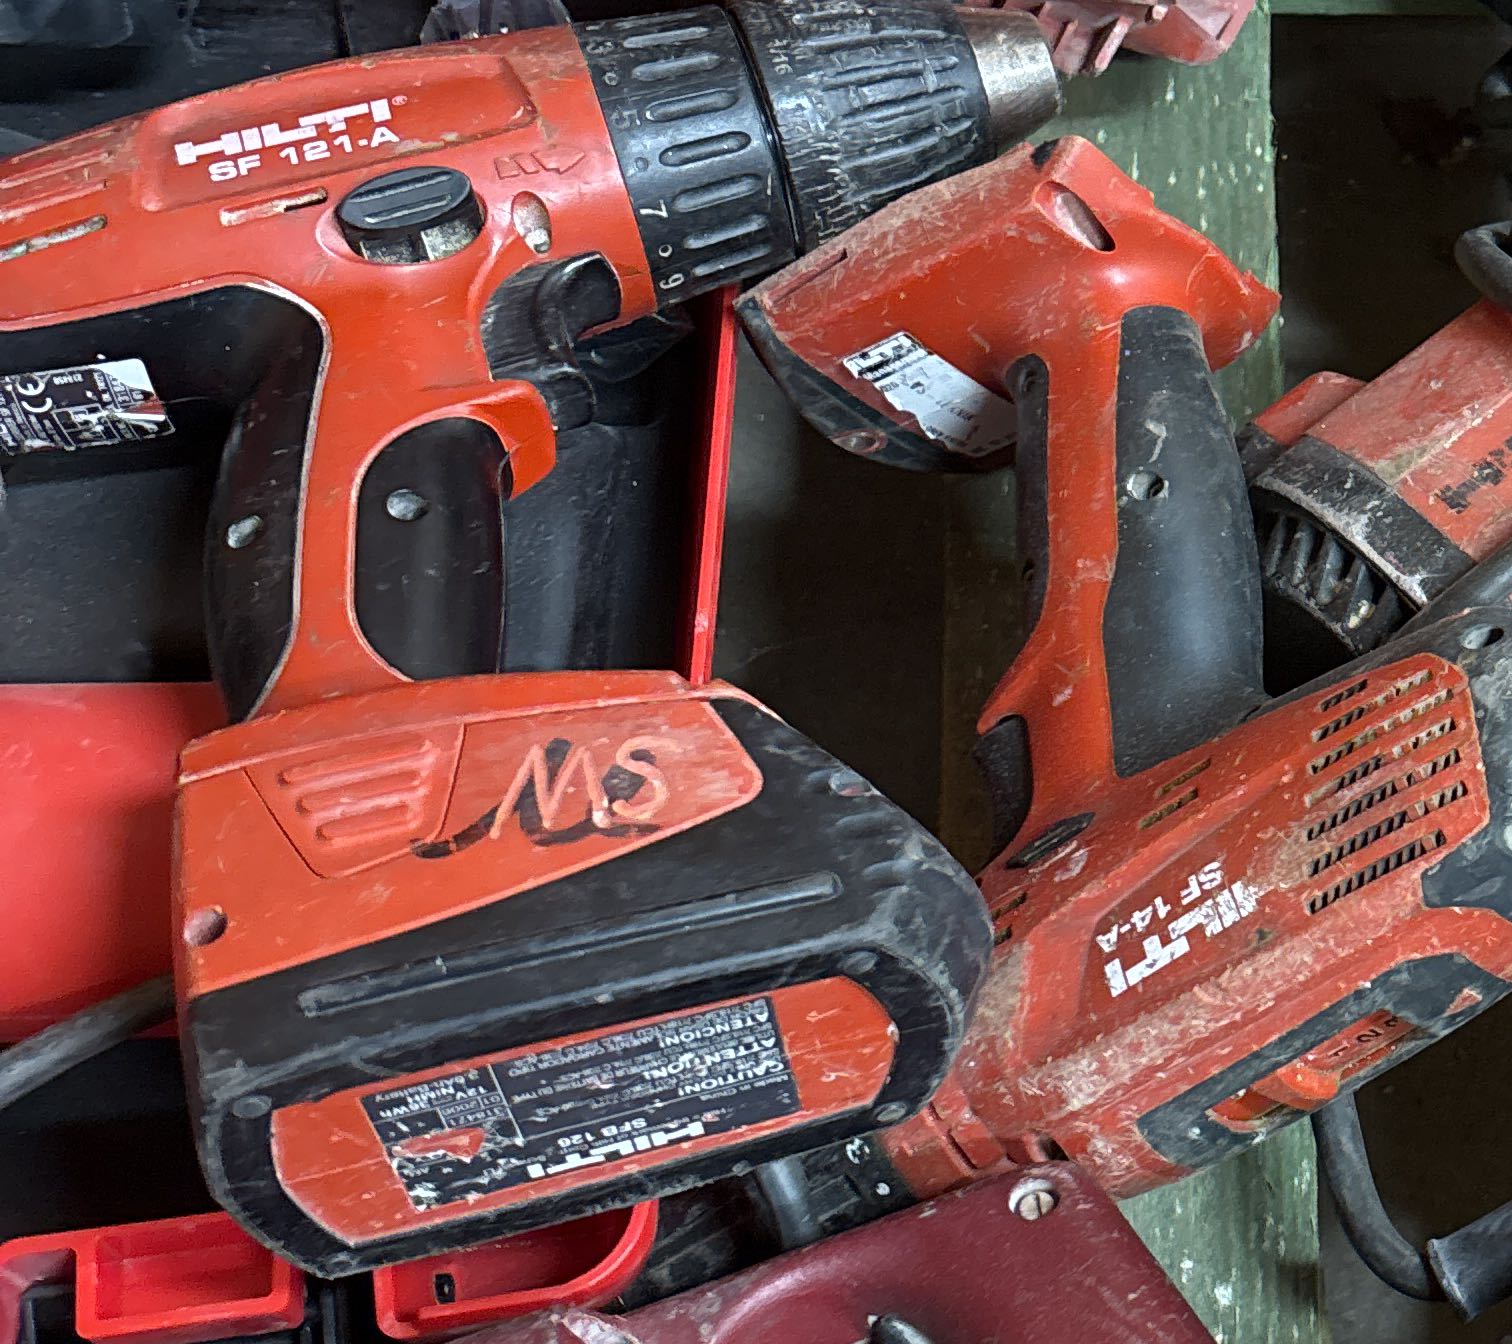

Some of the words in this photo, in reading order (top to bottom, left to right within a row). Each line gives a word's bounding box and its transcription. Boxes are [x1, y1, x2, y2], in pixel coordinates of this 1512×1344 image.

[173, 97, 392, 166] HILTI
[207, 155, 261, 183] SF
[639, 199, 669, 218] 7
[659, 272, 685, 290] 9
[1179, 861, 1225, 906] SF
[1095, 895, 1172, 953] 14-A
[1356, 1027, 1383, 1043] 2
[676, 1060, 784, 1096] CAUTION!
[600, 1116, 647, 1137] SFB
[526, 1121, 705, 1178] HILTI
